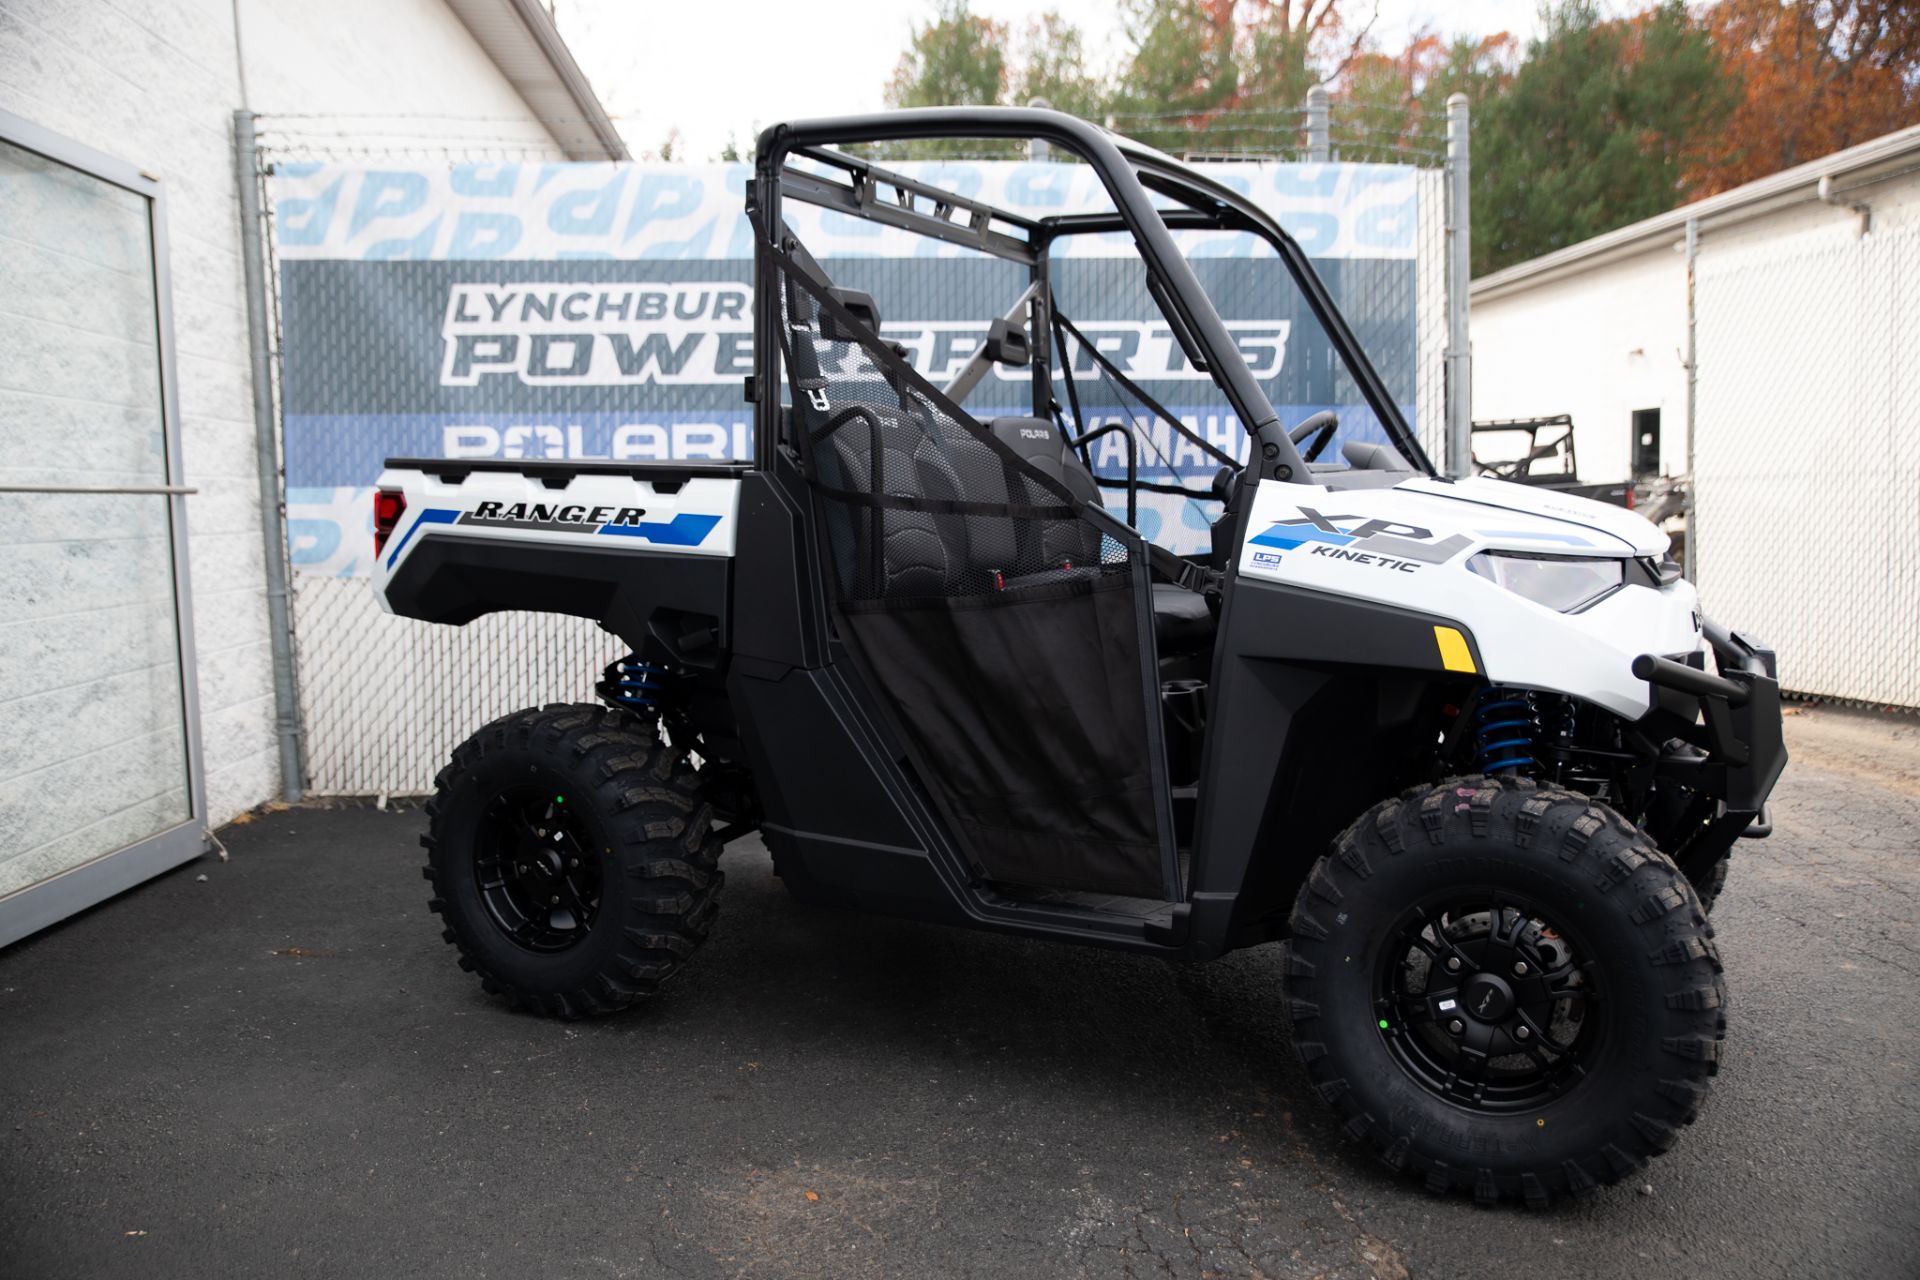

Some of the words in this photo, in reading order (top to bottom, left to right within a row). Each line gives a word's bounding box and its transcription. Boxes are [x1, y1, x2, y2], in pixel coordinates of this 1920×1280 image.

[453, 291, 755, 322] LYNCHBUR
[443, 423, 755, 459] POLARI
[474, 500, 648, 527] RANGER
[1270, 506, 1434, 540] XP
[1311, 545, 1421, 574] KINETIC
